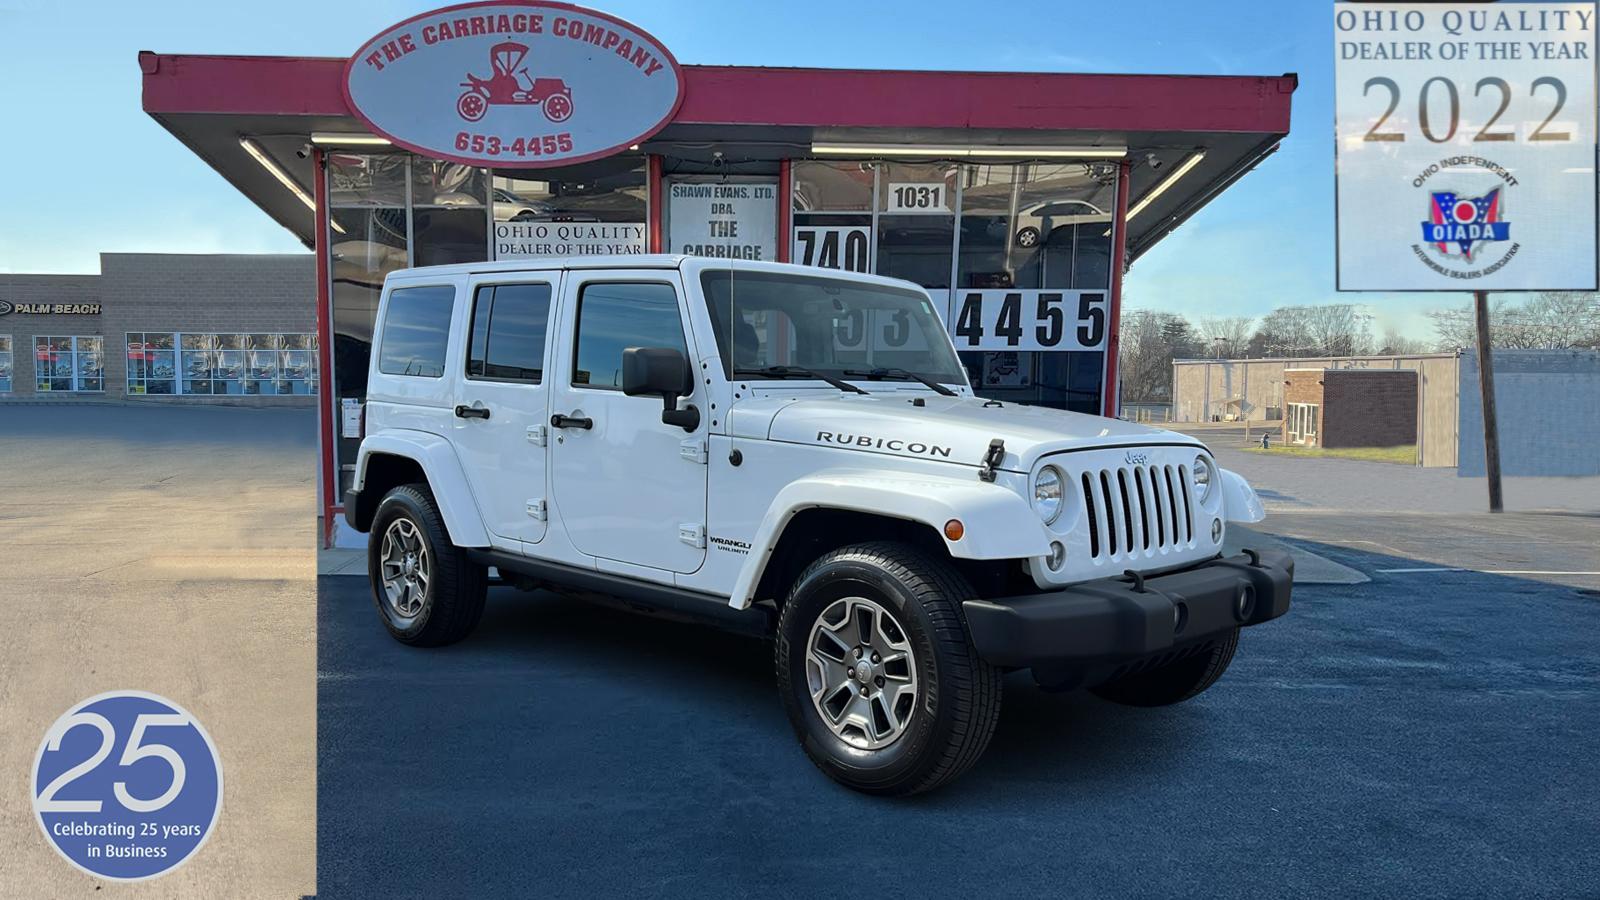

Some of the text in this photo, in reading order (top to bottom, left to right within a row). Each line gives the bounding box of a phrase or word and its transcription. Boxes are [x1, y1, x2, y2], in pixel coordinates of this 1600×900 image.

[1336, 10, 1593, 36] OHIO QUALITY
[366, 14, 664, 77] THE CARRIAGE COMPANY
[1340, 42, 1589, 60] DEALER OF THE YEAR
[1362, 75, 1571, 144] 2022
[455, 132, 573, 156] 653-4455
[1412, 156, 1519, 188] OHIO INDEPENDENT
[672, 186, 712, 199] SHAWN
[754, 187, 775, 200] LTD.
[895, 186, 940, 209] 1031
[711, 203, 736, 216] DBA.
[497, 225, 645, 242] OHIO QUALITY
[708, 220, 737, 238] THE
[1432, 225, 1496, 241] OIADA
[500, 243, 642, 256] DEALER OF THE YEAR
[682, 244, 762, 262] CARRIAGE
[797, 229, 868, 274] 740
[1411, 244, 1449, 277] AUTOMOBILE
[1450, 270, 1482, 280] DEALERS
[15, 304, 100, 315] PALM BEACH
[956, 293, 1105, 347] 4455
[817, 431, 953, 458] RUBICON
[1125, 451, 1148, 465] Jeep
